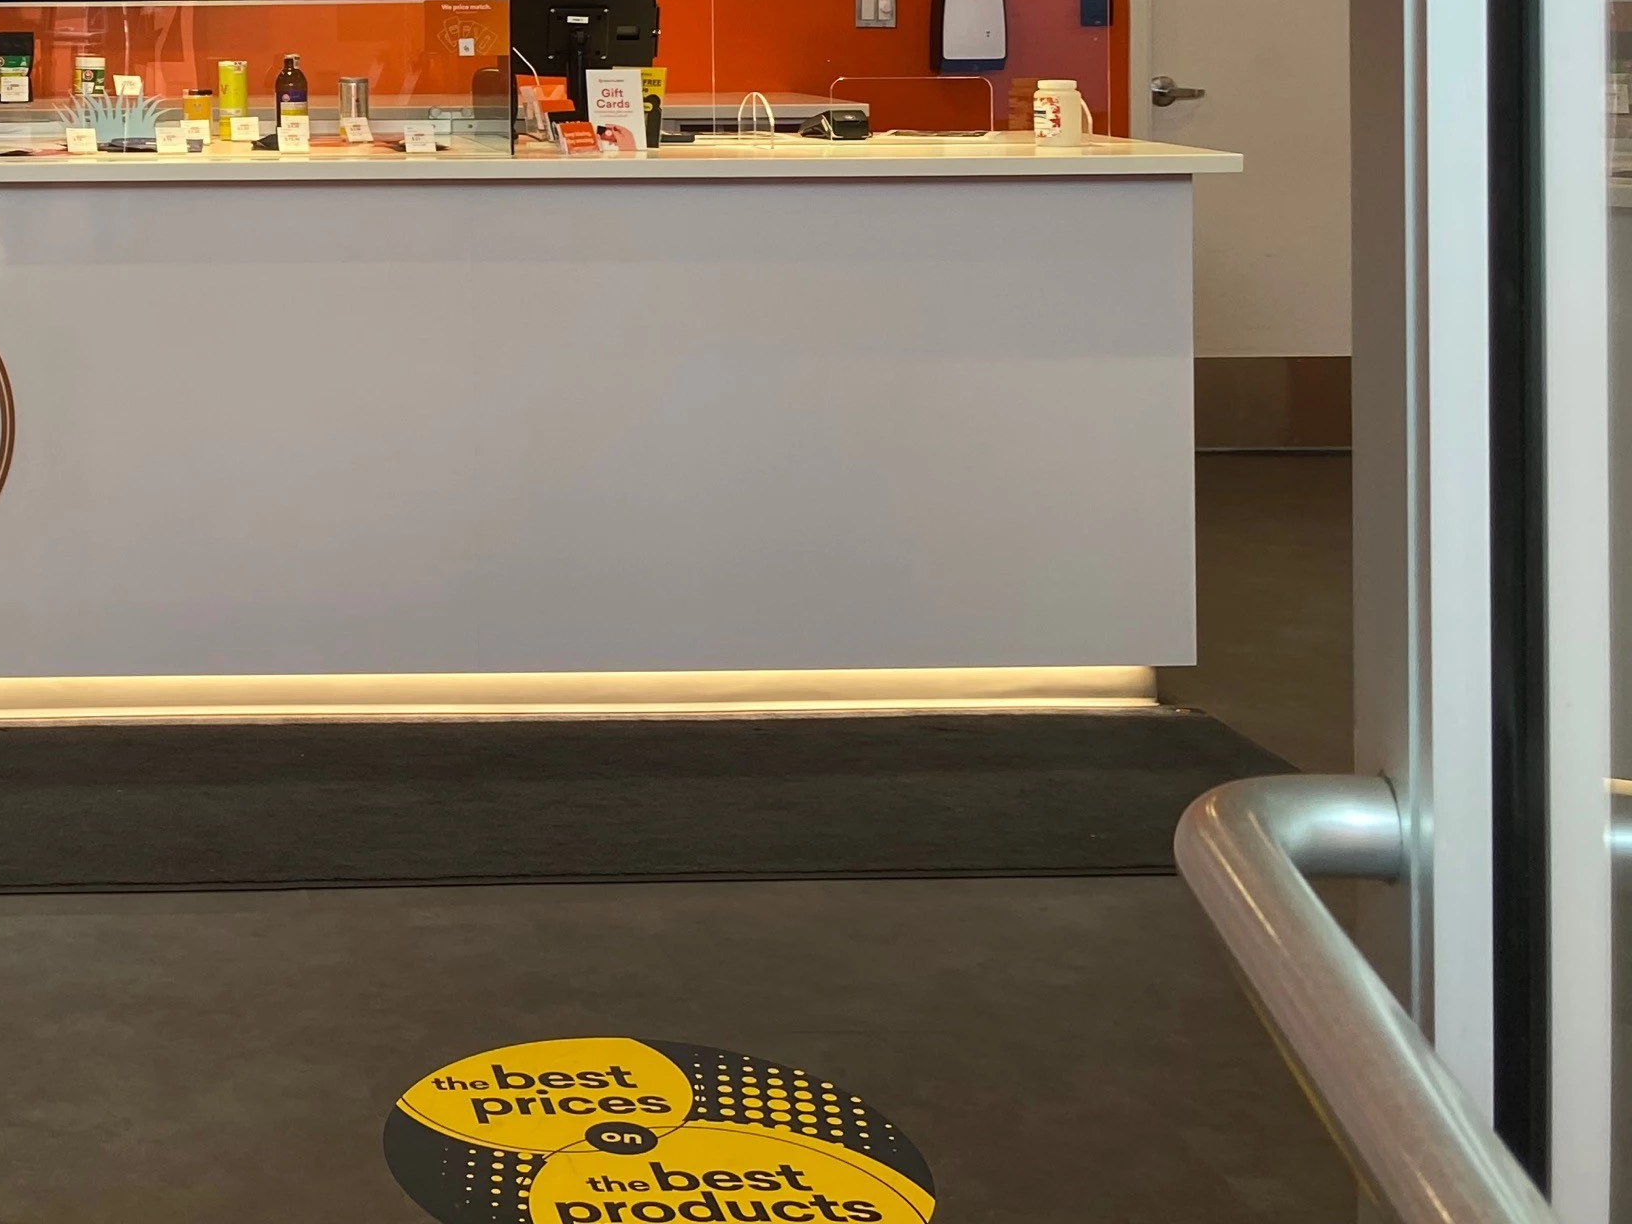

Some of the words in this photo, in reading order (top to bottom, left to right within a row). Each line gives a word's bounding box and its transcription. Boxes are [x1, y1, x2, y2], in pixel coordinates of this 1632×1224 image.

[453, 4, 469, 12] price
[601, 88, 624, 98] Gift
[596, 99, 631, 109] Cards
[431, 1076, 490, 1091] the
[491, 1064, 638, 1090] best
[471, 1089, 672, 1124] prices
[601, 1131, 642, 1145] on
[586, 1175, 650, 1192] the
[649, 1162, 813, 1192] best
[555, 1191, 883, 1224] products
